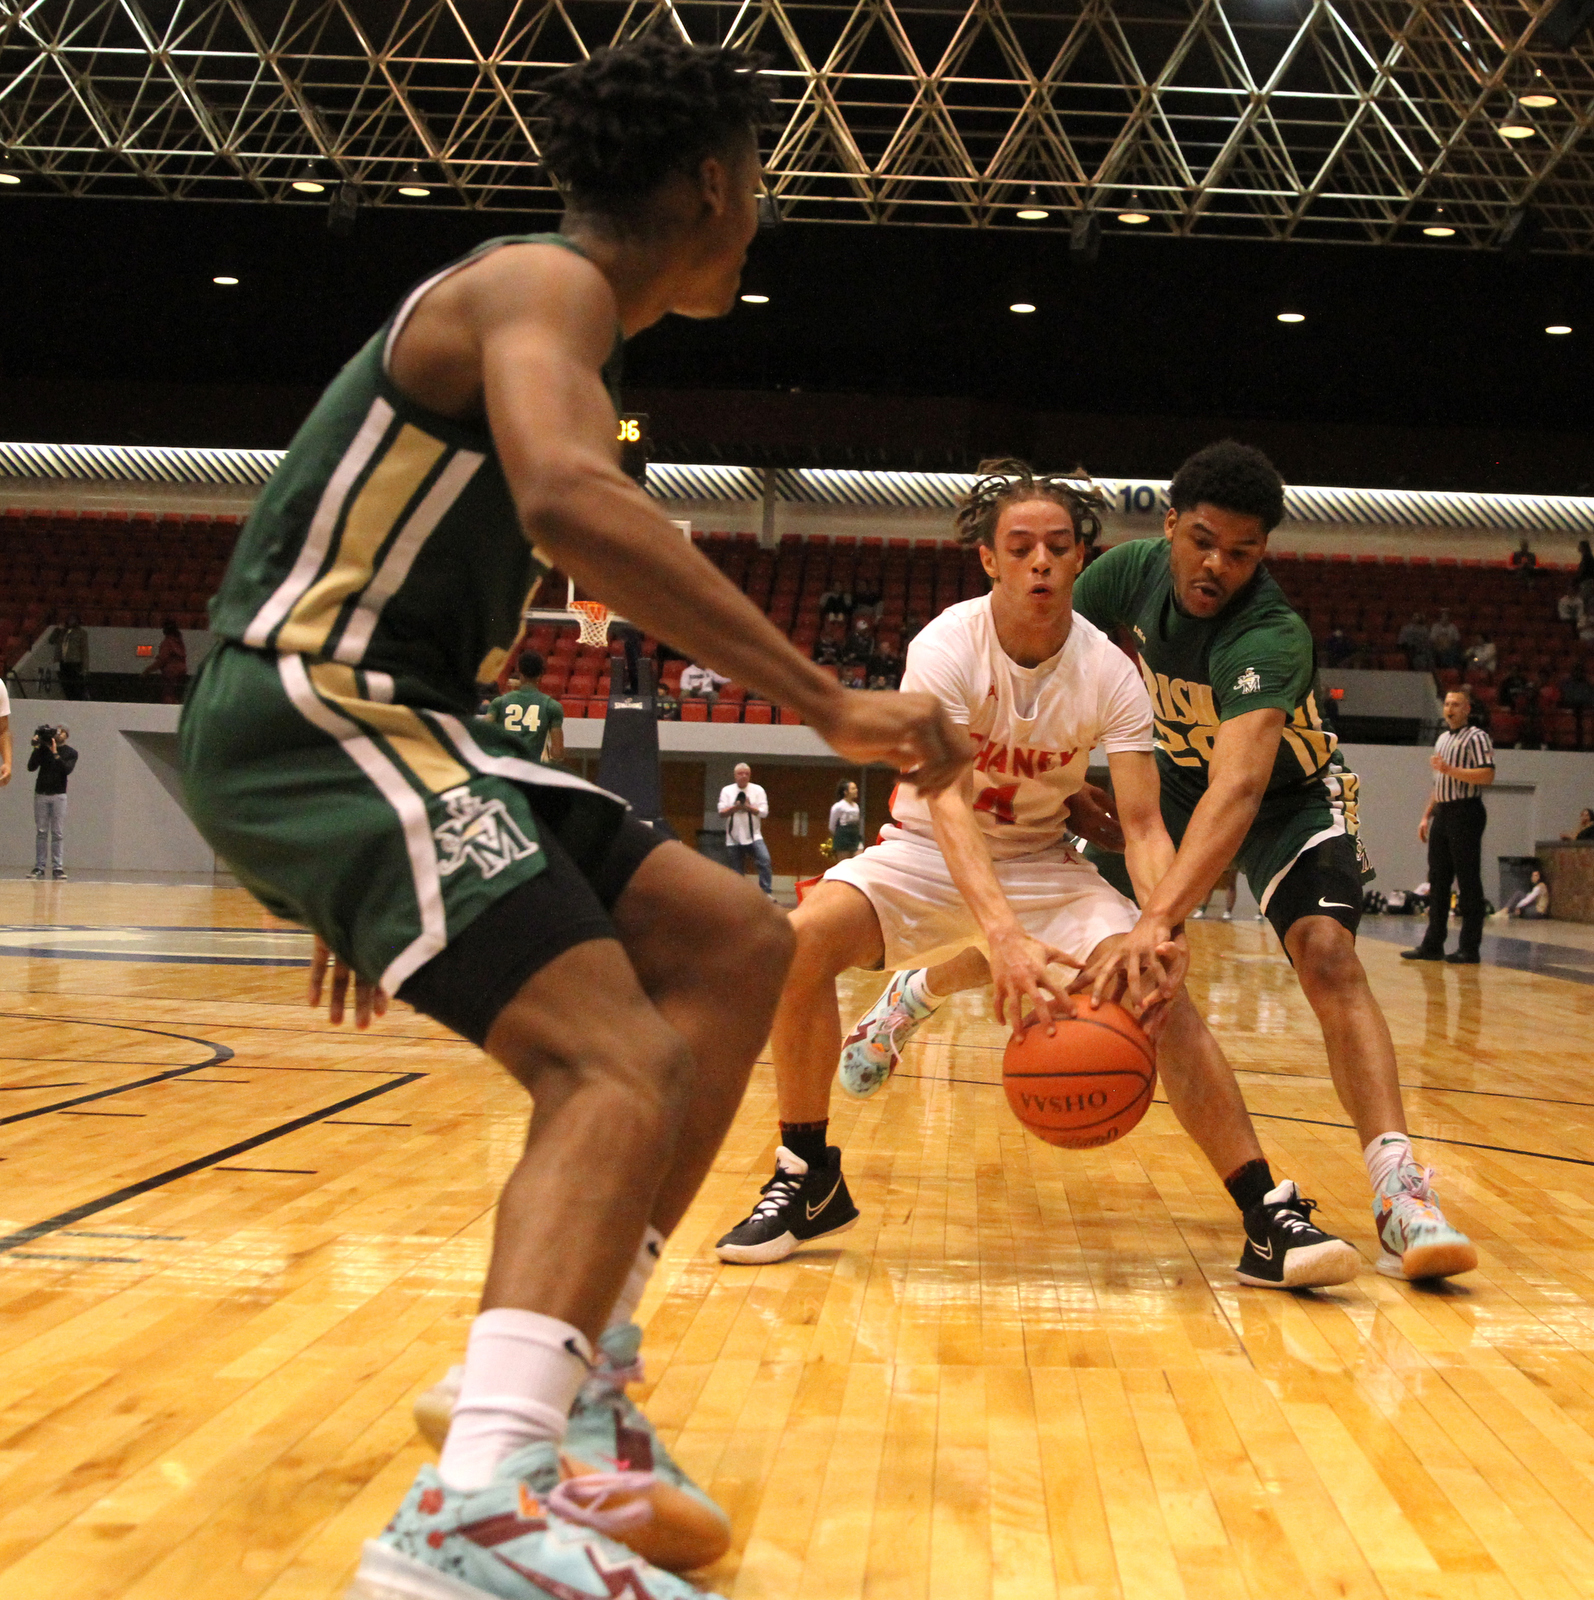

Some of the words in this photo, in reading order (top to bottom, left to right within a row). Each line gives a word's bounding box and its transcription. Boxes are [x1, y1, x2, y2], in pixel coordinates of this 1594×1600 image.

[1119, 485, 1155, 512] 10
[504, 704, 541, 732] 24
[1021, 1090, 1108, 1114] OHSAA
